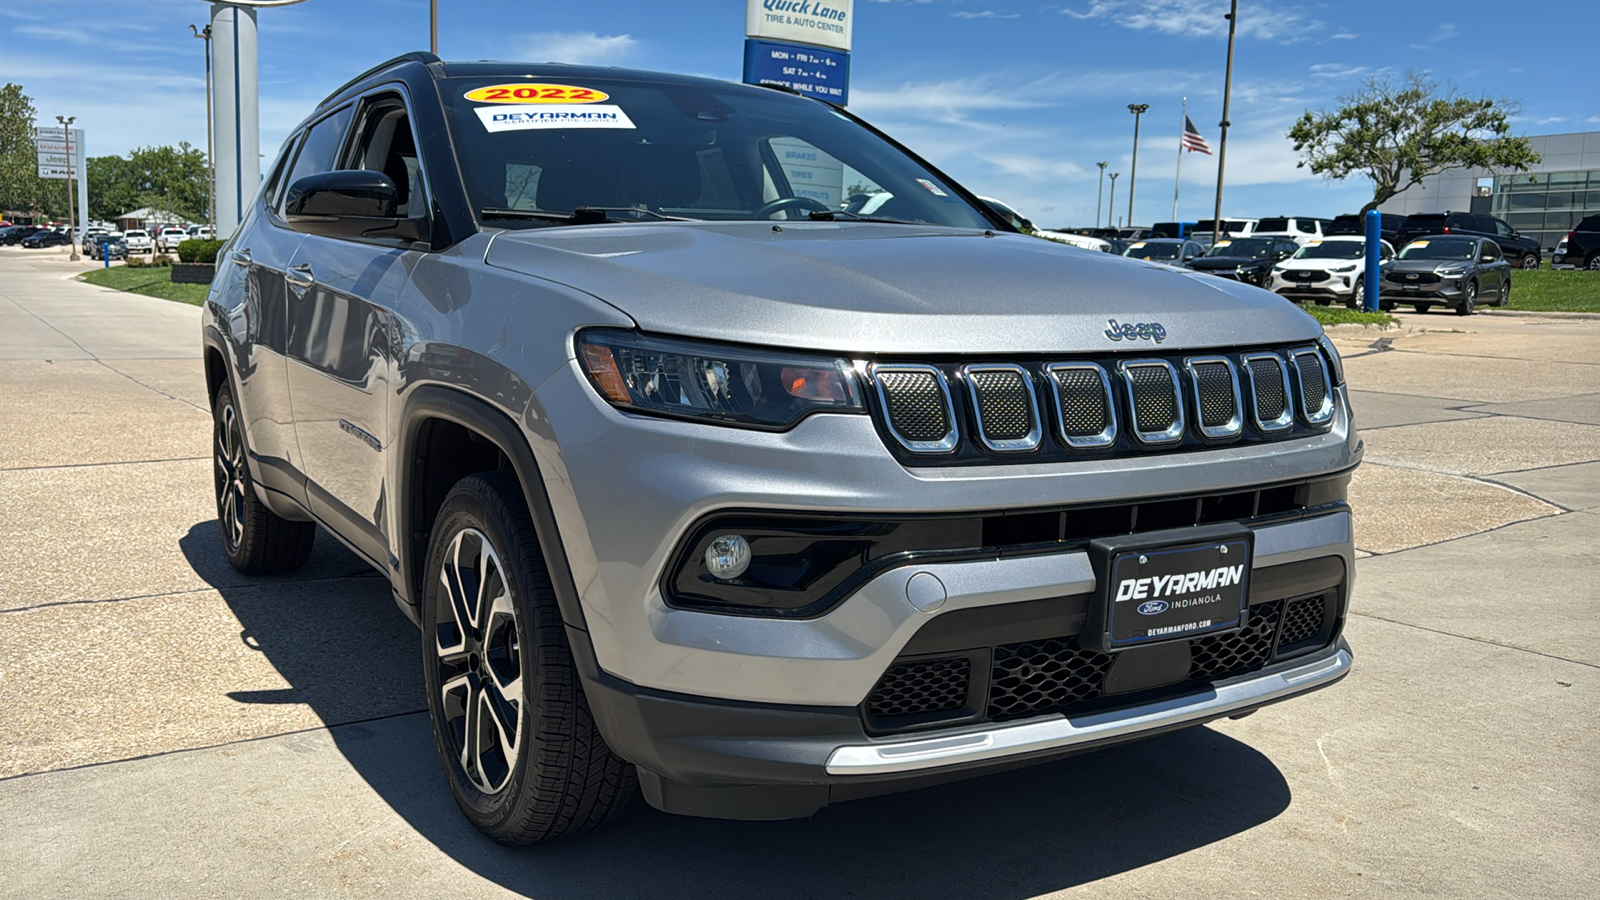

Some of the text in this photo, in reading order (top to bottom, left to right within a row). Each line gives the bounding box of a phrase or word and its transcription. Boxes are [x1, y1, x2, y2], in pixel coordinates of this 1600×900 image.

[763, 0, 846, 21] Quick Lane
[766, 14, 784, 23] TIRE
[794, 18, 816, 28] AUTO
[816, 22, 844, 33] CENTER
[772, 50, 788, 59] MON
[796, 54, 808, 62] FRI
[484, 88, 595, 100] 2022
[792, 82, 814, 92] WHILE
[816, 86, 828, 94] YOU
[492, 112, 617, 122] DEYARMAN
[786, 152, 816, 160] BRAKES
[1104, 319, 1167, 344] Jeep
[1115, 564, 1244, 602] DEYARMAN
[1171, 593, 1222, 609] INDIANOLA
[1148, 620, 1212, 636] DEYARMANFORD.COM
